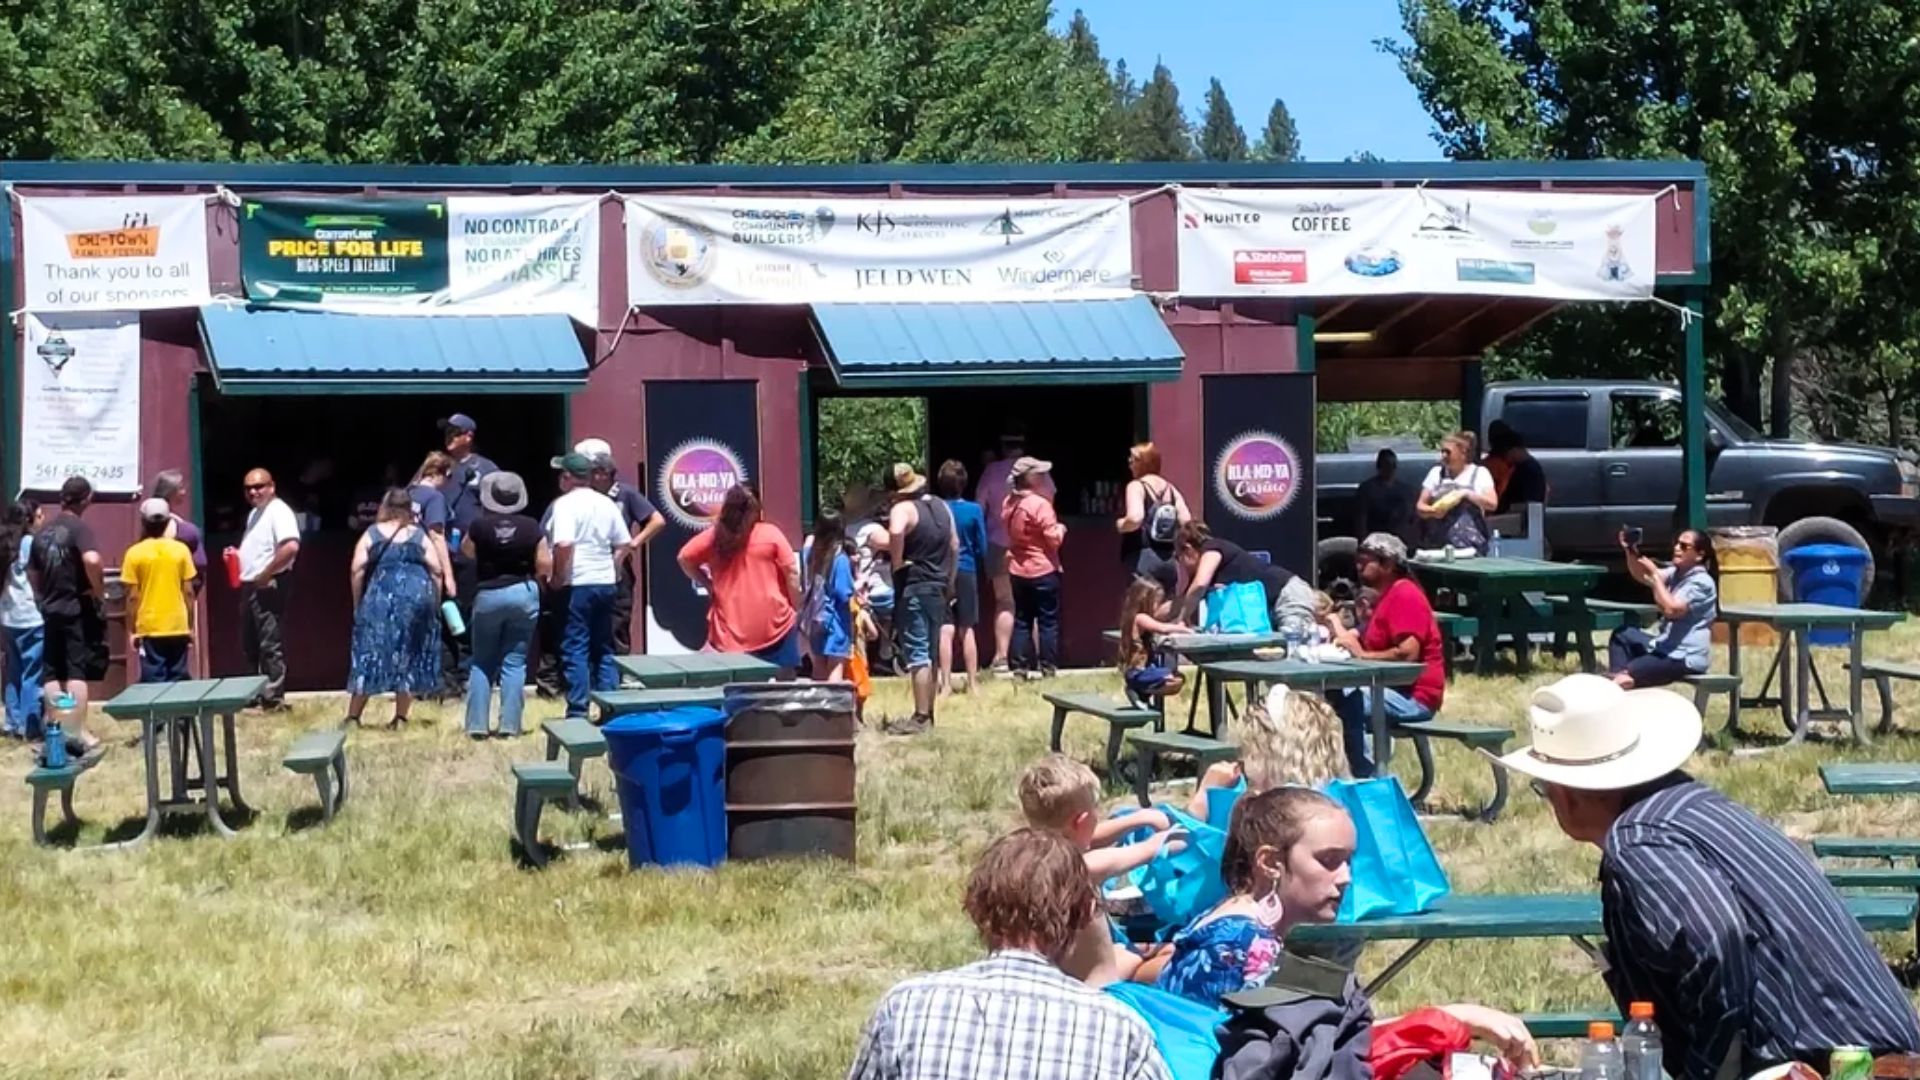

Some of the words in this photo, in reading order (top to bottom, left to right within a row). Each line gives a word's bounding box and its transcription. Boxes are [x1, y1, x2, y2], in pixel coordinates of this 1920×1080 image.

[857, 208, 896, 237] KJS
[1203, 213, 1261, 224] HUNTER
[1292, 217, 1351, 232] COFFEE
[465, 219, 488, 234] NO
[732, 233, 804, 244] BUILDERS
[268, 241, 330, 257] PRICE
[335, 241, 376, 257] FOR
[381, 241, 423, 257] LIFE
[465, 249, 488, 263] NO
[44, 263, 100, 280] Thank
[108, 265, 140, 283] you
[147, 263, 163, 279] to
[169, 261, 190, 277] all
[353, 258, 396, 273] INTERNET
[997, 266, 1111, 284] Windermere
[46, 289, 64, 304] of
[69, 290, 99, 304] our
[1234, 481, 1287, 498] Casino
[680, 489, 725, 507] Casin
